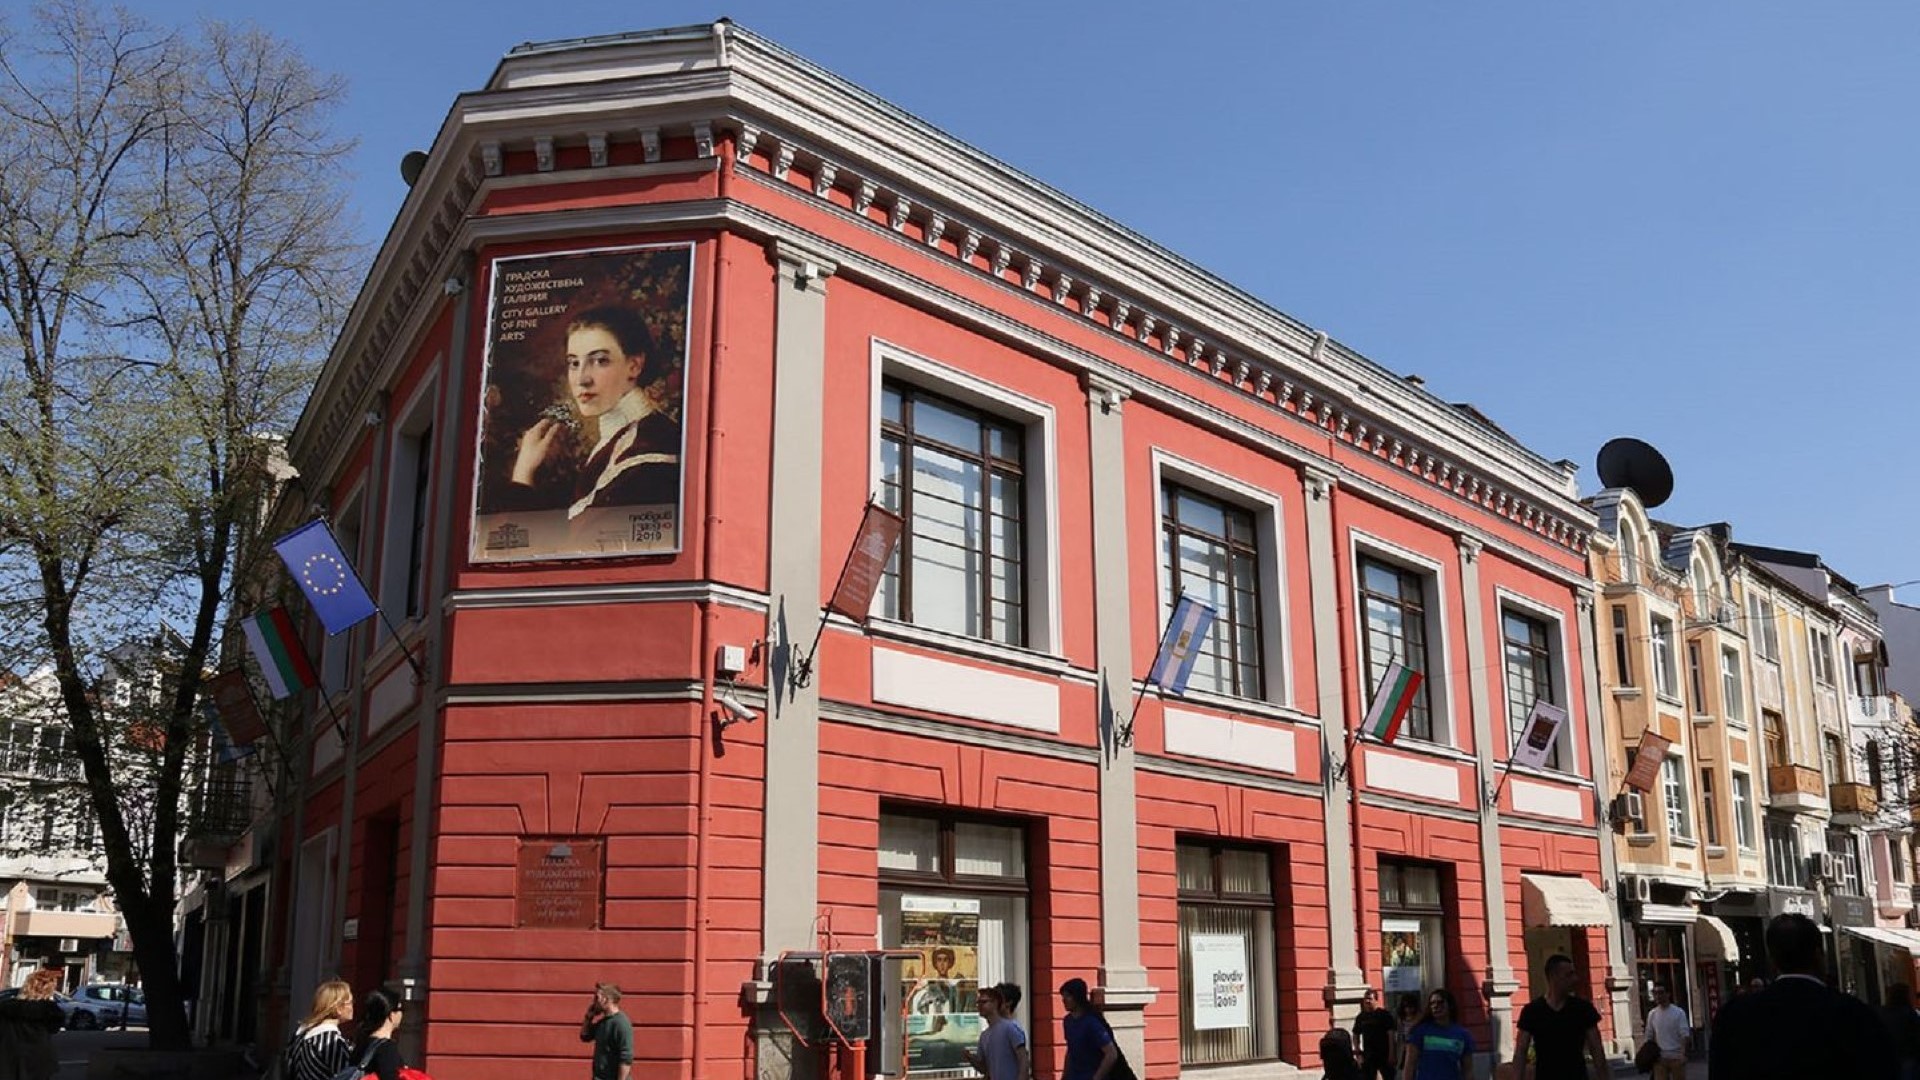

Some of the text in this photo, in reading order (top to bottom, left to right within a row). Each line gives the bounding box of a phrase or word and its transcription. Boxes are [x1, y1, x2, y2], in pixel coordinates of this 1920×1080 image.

[505, 269, 550, 281] ГРАДСКА
[504, 278, 584, 293] ХУДОЖЕСТВЕНА
[503, 292, 549, 304] ГАЛЕРИЯ
[501, 304, 568, 319] CITY GALLERY
[501, 319, 538, 331] OF FINE
[500, 331, 526, 342] ARTS
[636, 531, 662, 542] 2019
[1217, 995, 1238, 1008] 2019
